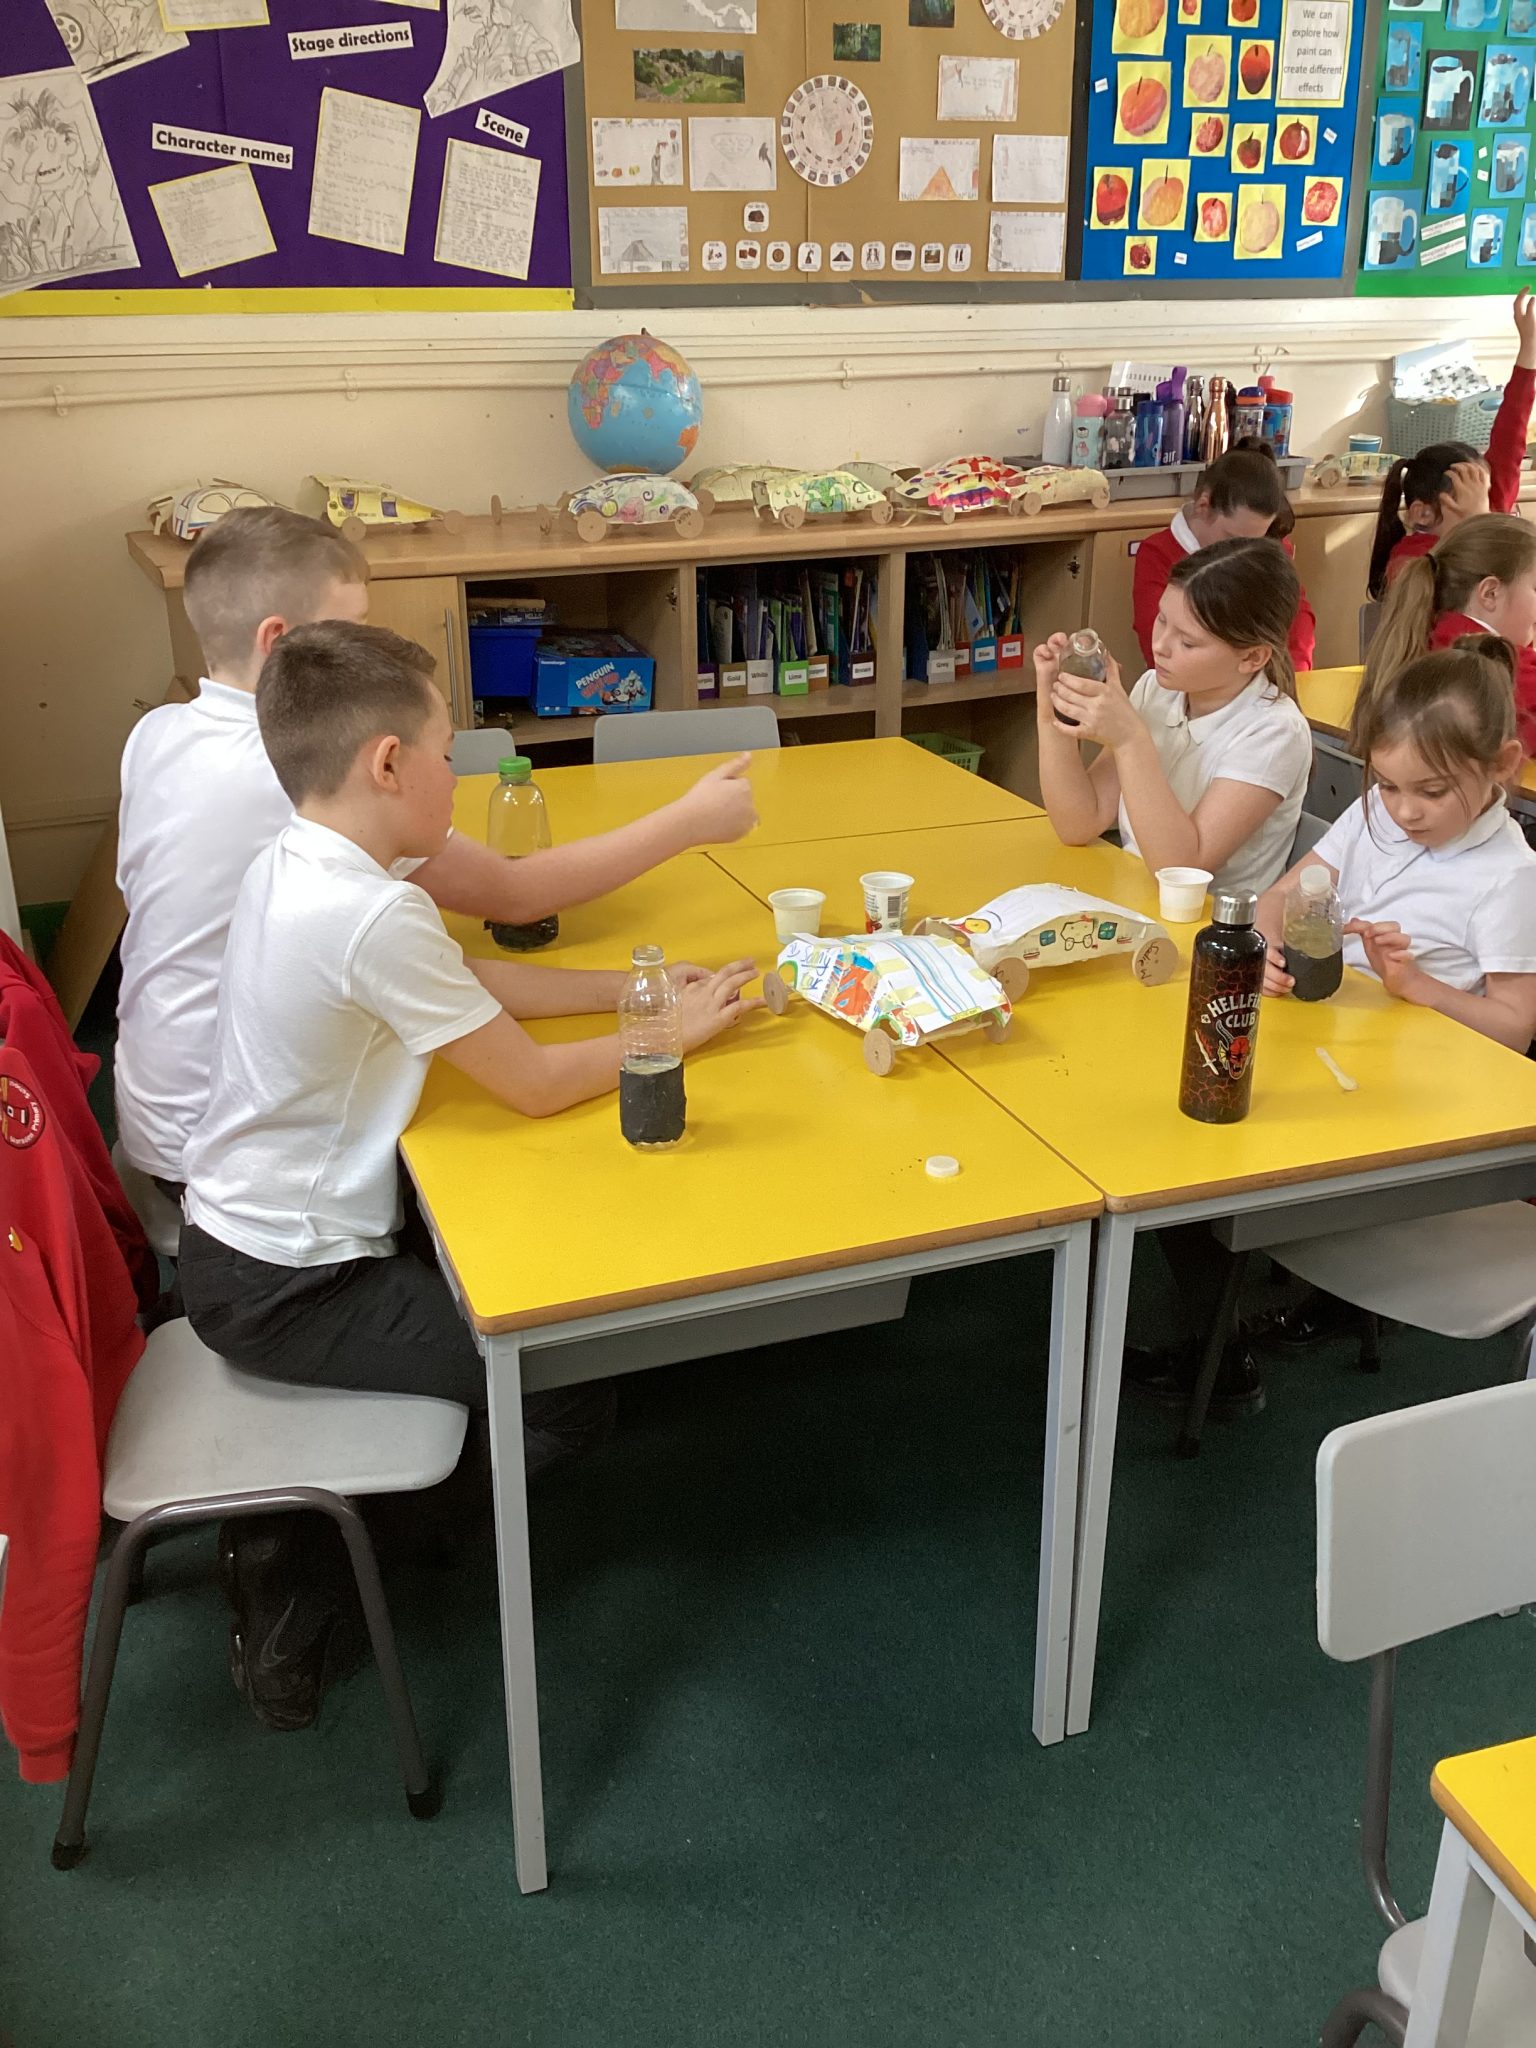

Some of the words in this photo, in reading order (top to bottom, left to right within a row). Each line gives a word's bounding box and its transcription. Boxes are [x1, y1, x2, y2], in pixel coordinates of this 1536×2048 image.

[1303, 9, 1315, 19] We
[1319, 11, 1332, 19] can
[1292, 28, 1321, 38] explore
[1323, 28, 1340, 38] how
[291, 34, 335, 53] Stage
[338, 28, 410, 48] directions
[1296, 47, 1317, 57] paint
[1319, 48, 1332, 56] can
[1283, 64, 1307, 74] create
[1309, 64, 1342, 75] different
[1298, 82, 1324, 93] effects
[482, 114, 523, 142] Scene
[156, 130, 237, 156] Character
[240, 141, 290, 164] names
[575, 662, 615, 690] PENGUIN
[1225, 1011, 1256, 1028] CLUB
